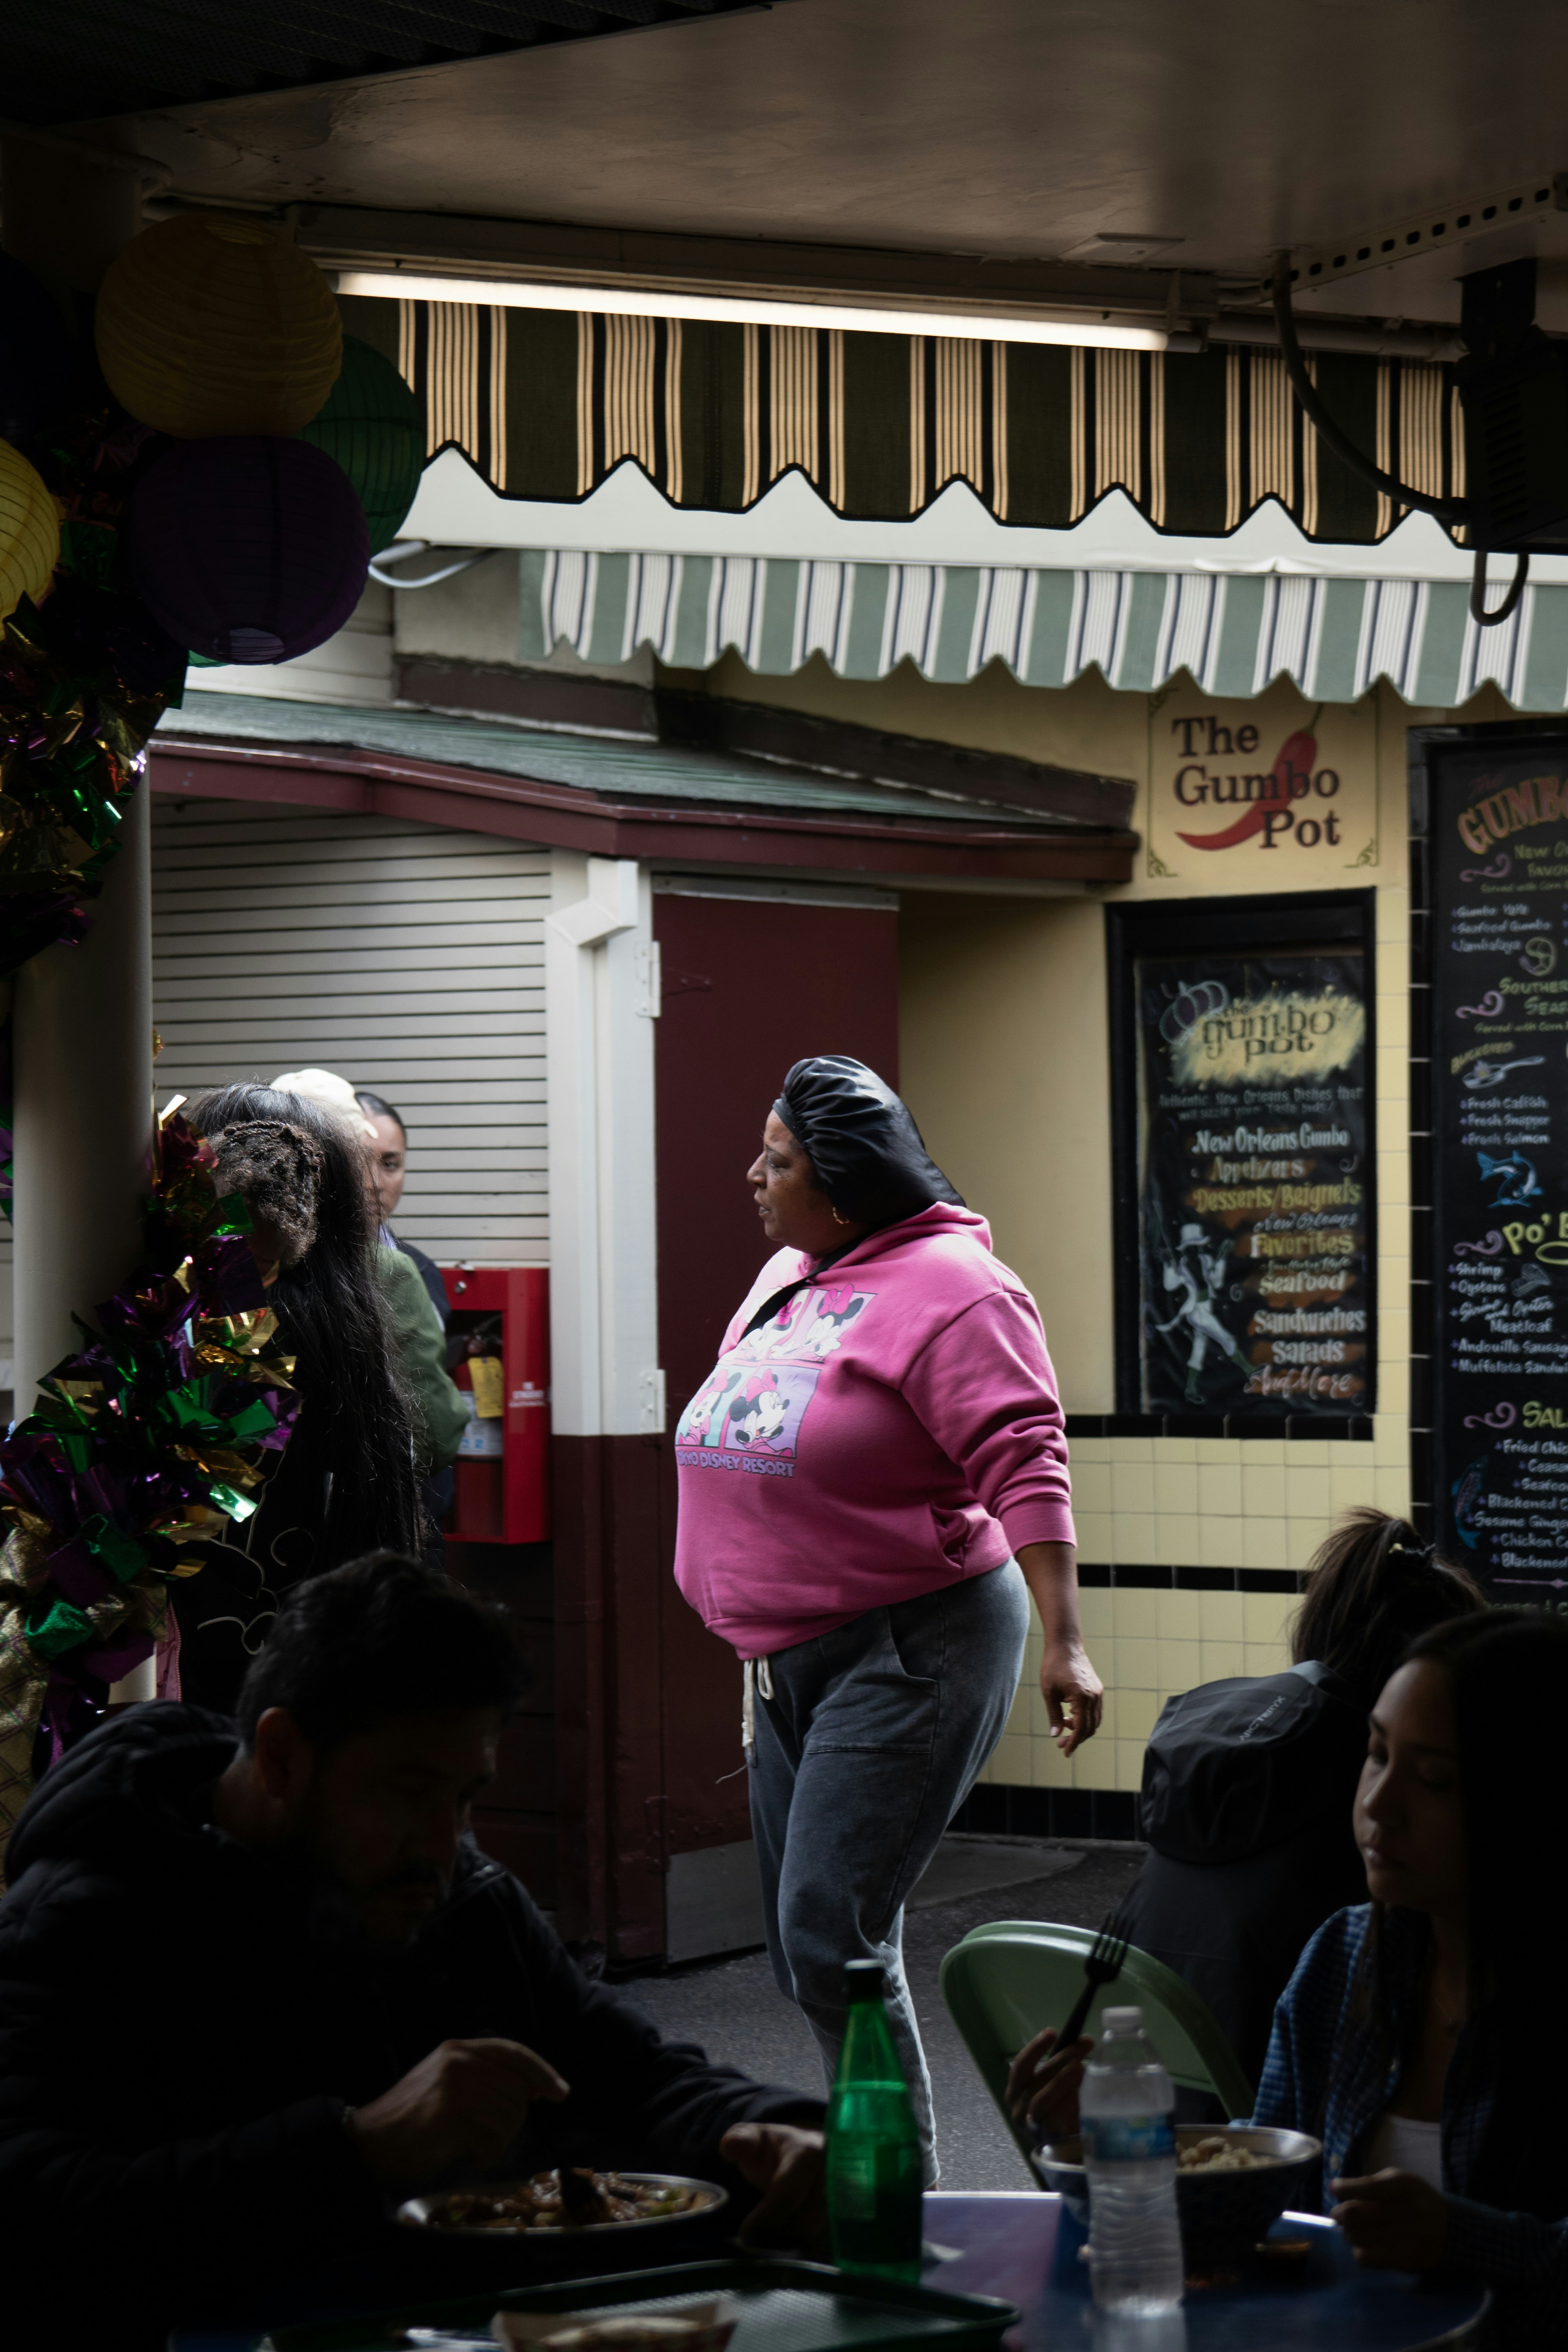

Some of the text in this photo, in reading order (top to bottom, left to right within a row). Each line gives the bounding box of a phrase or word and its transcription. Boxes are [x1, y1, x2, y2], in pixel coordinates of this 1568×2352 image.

[1172, 717, 1259, 757] The
[1174, 761, 1339, 805] Gumbo
[1259, 809, 1340, 849] Pot
[1509, 917, 1553, 932] Gumbo
[1245, 1033, 1314, 1063] pot
[1243, 1088, 1290, 1105] Orleans
[1467, 1096, 1502, 1110] Fresh
[1467, 1112, 1551, 1131] Fresh Snapper
[1191, 1121, 1350, 1154] New Orleans Gumbo
[1467, 1131, 1551, 1146] Fresh Salmon
[1211, 1154, 1307, 1184] Appetizers
[1253, 1212, 1358, 1233] New Orleans
[1250, 1229, 1355, 1259] Favorites
[1456, 1261, 1504, 1281] Shrimp
[1257, 1270, 1348, 1296] Seafood
[1458, 1278, 1507, 1297] Oysters
[1253, 1306, 1367, 1334] Sandwiches
[1489, 1316, 1555, 1334] Meatloaf
[1271, 1338, 1346, 1365] Salads
[1457, 1337, 1521, 1354] Andouille
[1522, 1400, 1568, 1429] SAL
[1502, 1438, 1540, 1454] Fried
[699, 1451, 740, 1470] DISNEY
[741, 1455, 795, 1478] RESORT
[1520, 1477, 1568, 1492] Seafoo
[1488, 1492, 1558, 1511] Blackened
[1474, 1510, 1527, 1528] Sesame
[1499, 1531, 1554, 1548] Chicken
